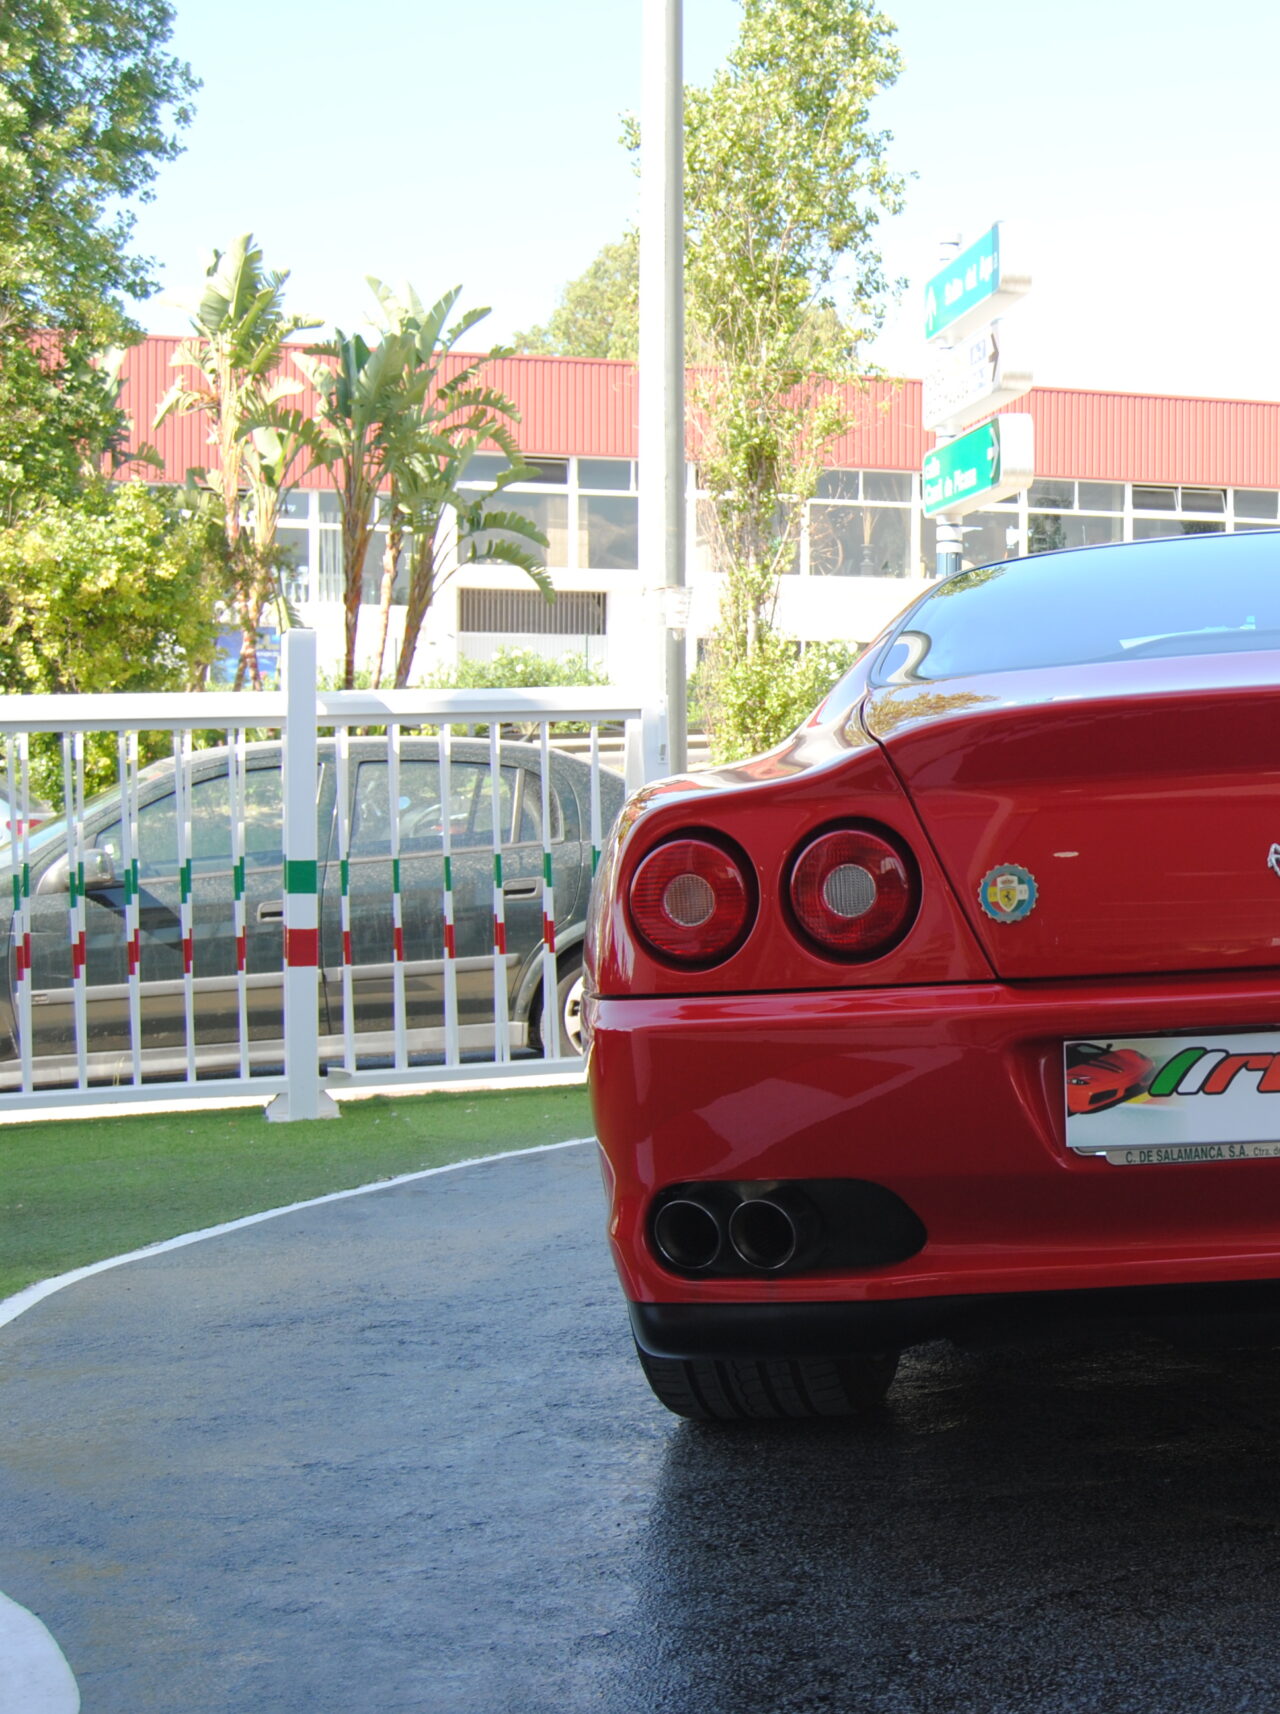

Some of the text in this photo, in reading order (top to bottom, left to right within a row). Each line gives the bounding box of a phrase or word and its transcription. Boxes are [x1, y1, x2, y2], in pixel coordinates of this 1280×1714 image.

[1126, 1151, 1138, 1164] C.
[1139, 1150, 1154, 1163] DE
[1228, 1144, 1249, 1158] S.A.
